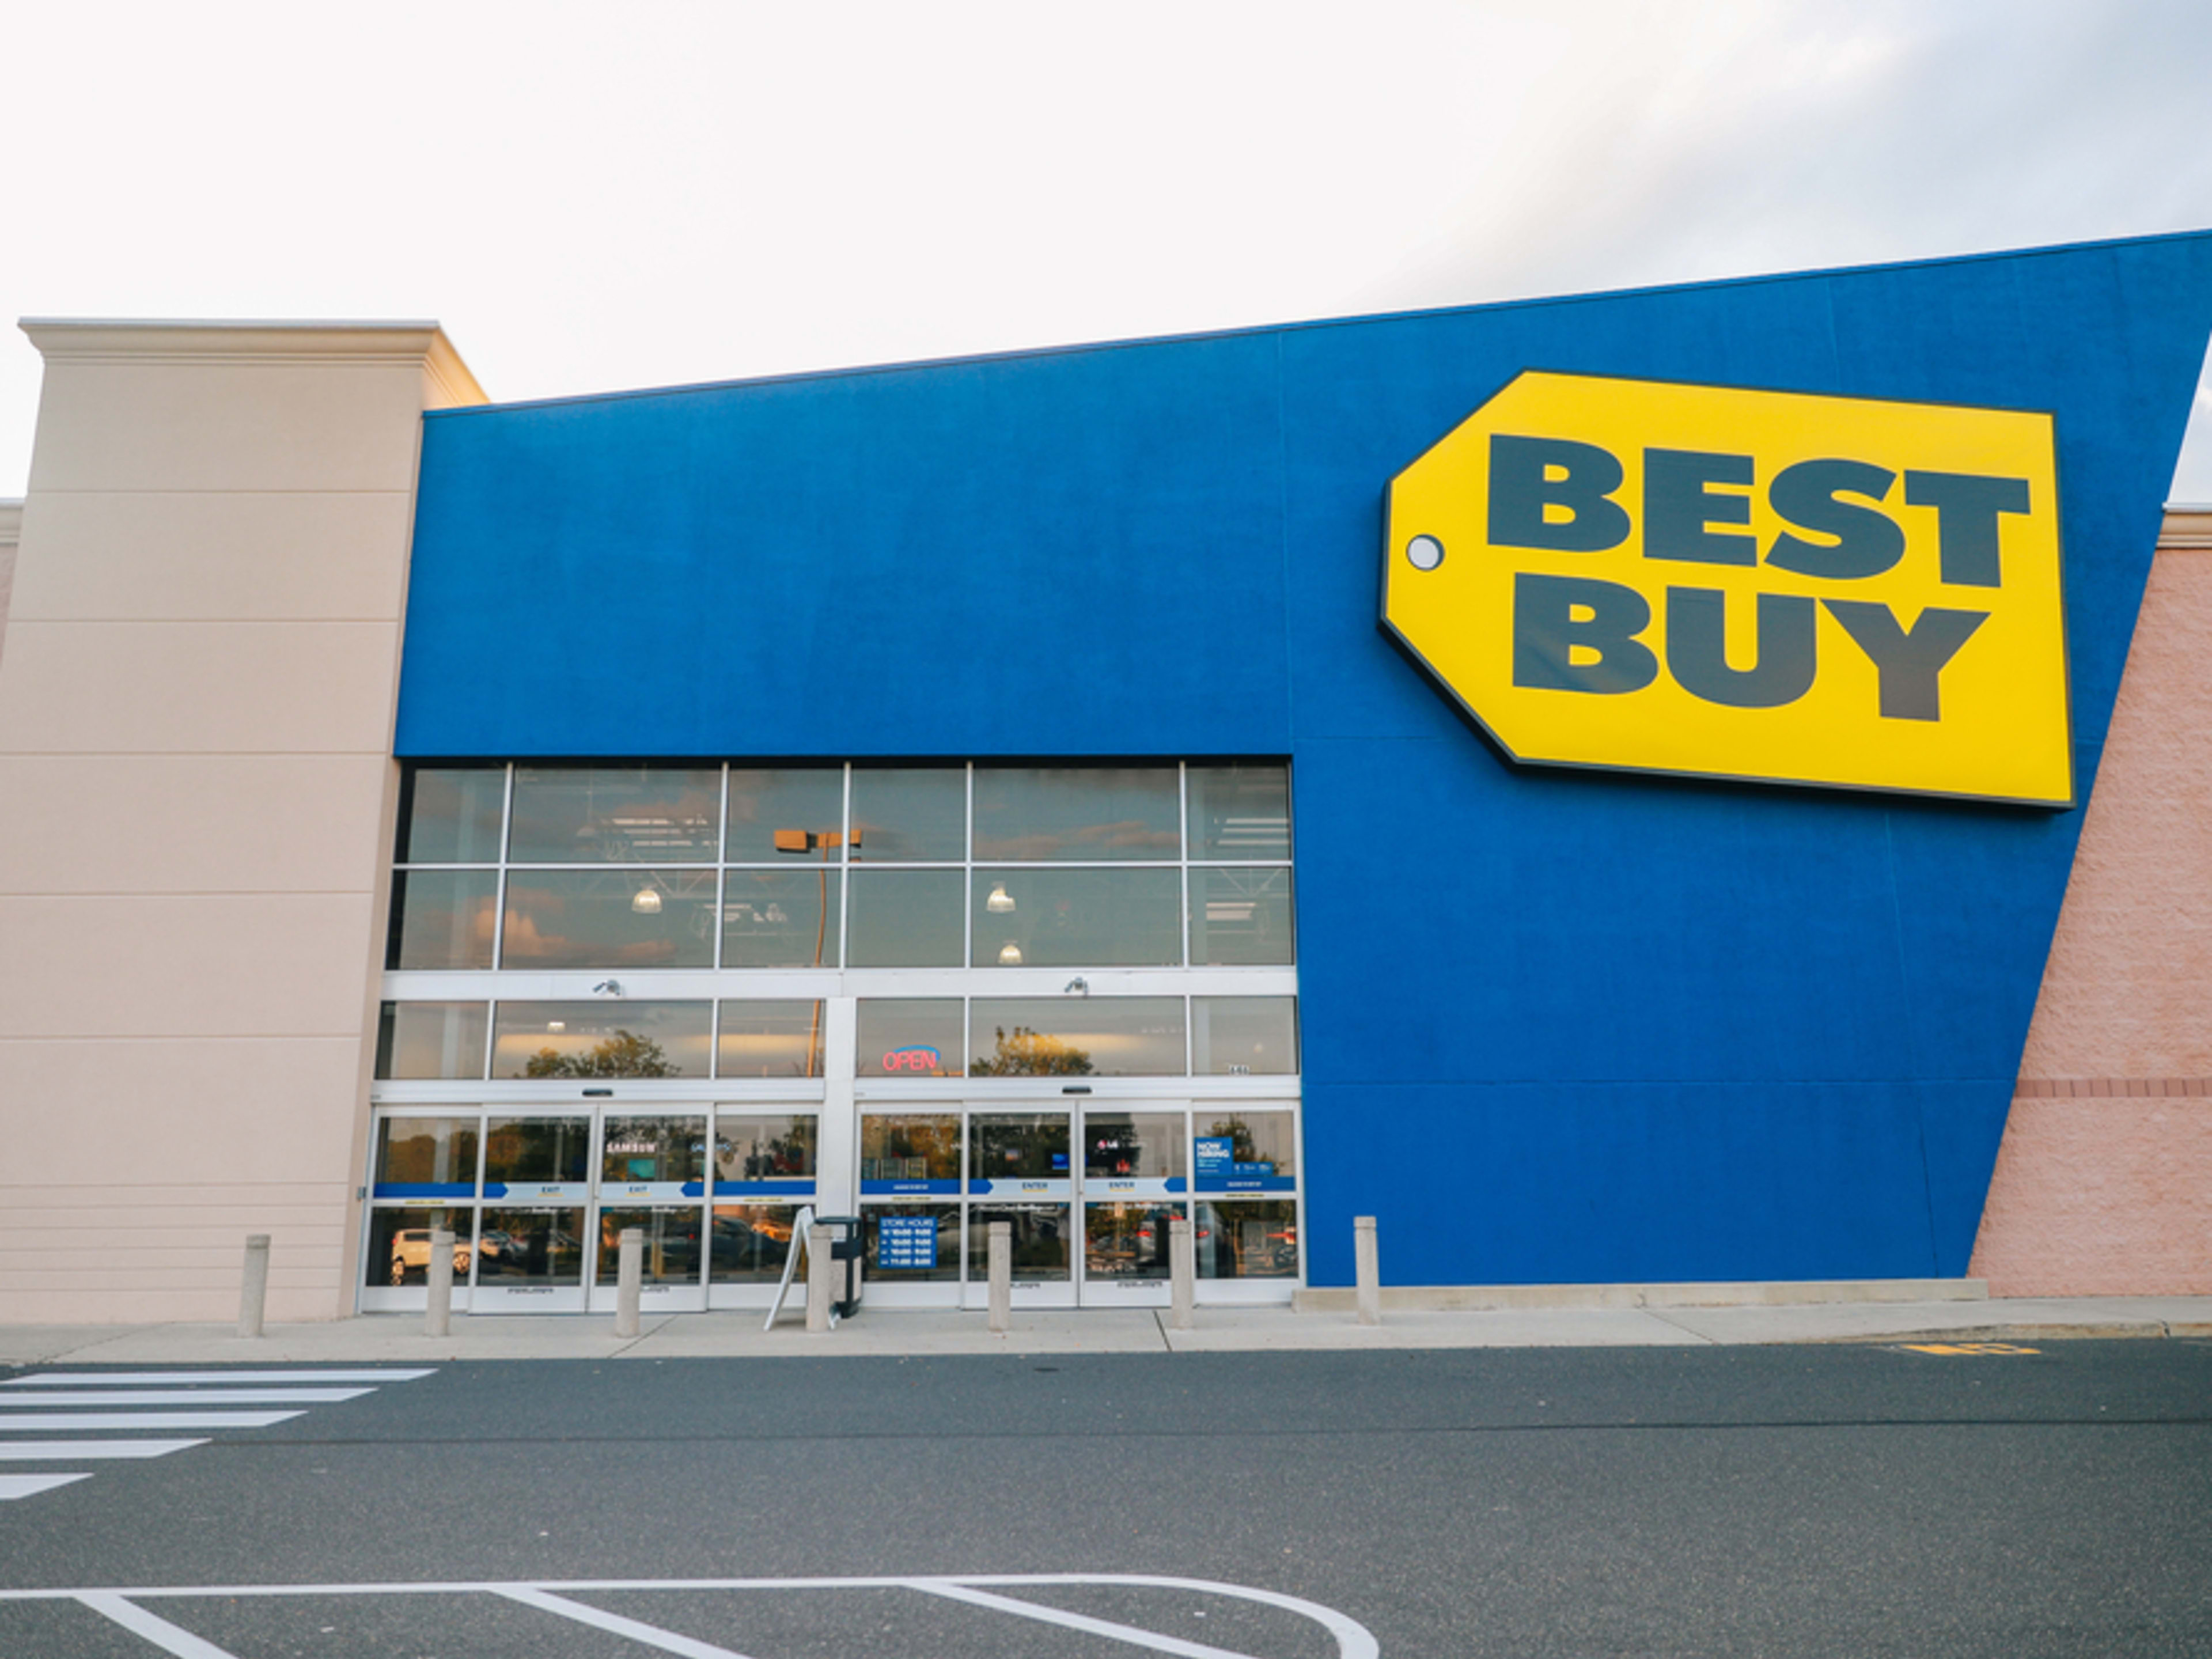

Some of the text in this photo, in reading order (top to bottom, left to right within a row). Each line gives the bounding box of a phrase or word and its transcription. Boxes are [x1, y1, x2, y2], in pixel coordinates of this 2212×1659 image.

[1487, 433, 2031, 589] BEST
[1512, 571, 1992, 723] BUY
[882, 1050, 936, 1071] OPEN
[607, 1142, 656, 1153] SAMSUN
[1196, 1149, 1230, 1158] HIRING
[880, 1218, 934, 1227] STORE HOURS
